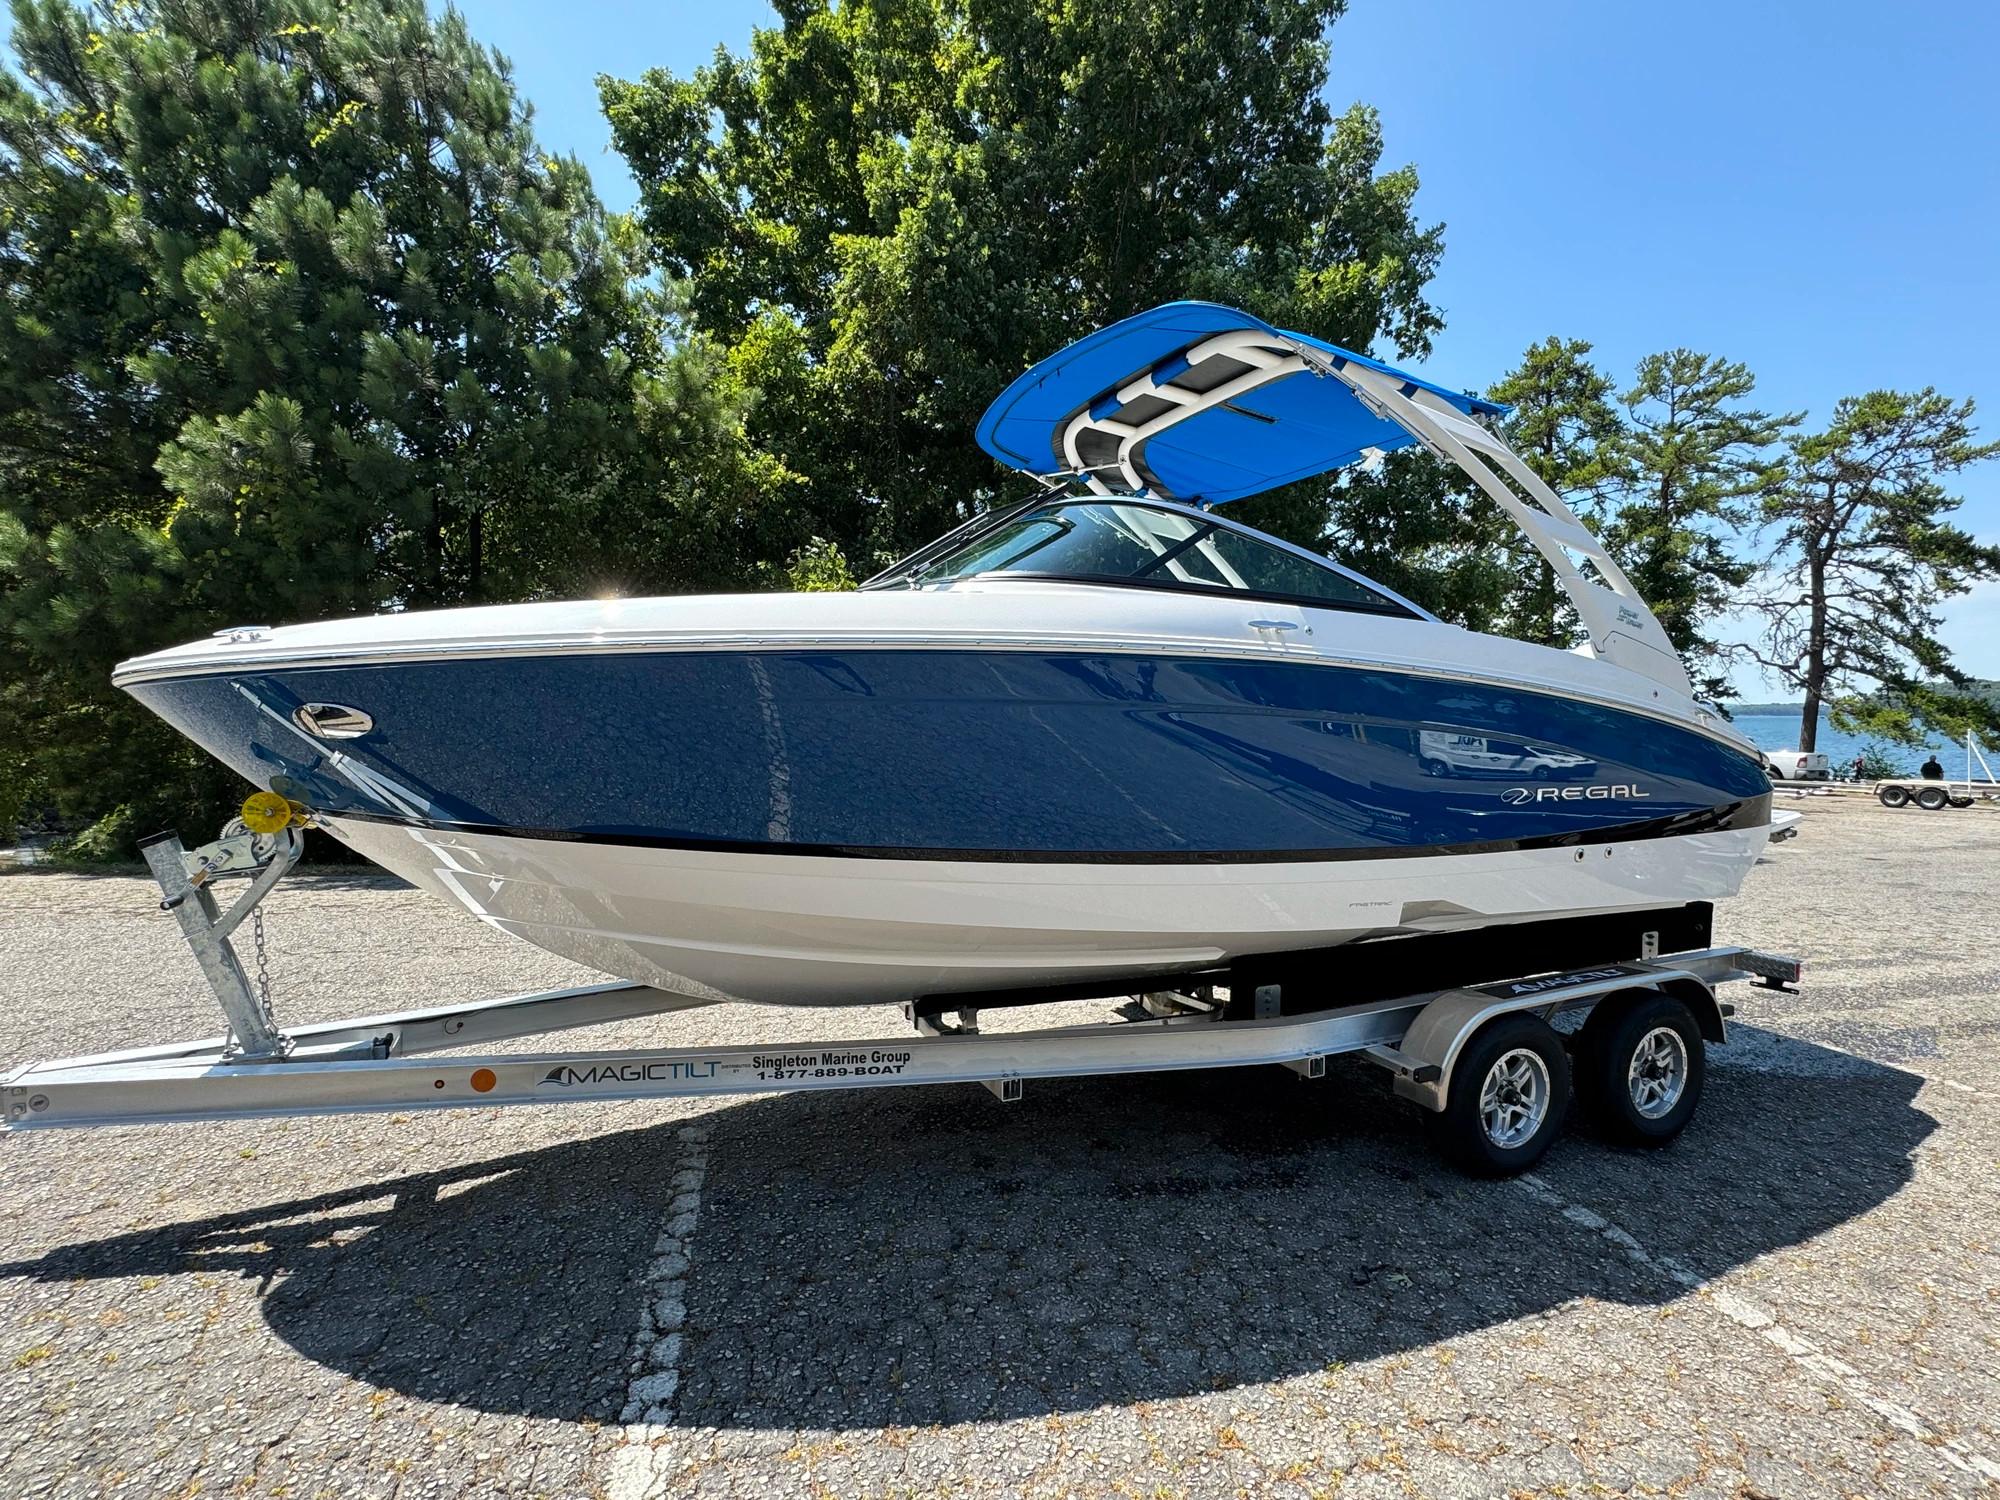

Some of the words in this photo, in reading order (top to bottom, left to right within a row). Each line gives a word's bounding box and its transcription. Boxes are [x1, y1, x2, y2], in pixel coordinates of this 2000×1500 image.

[1536, 784, 1650, 802] REGAL
[752, 1054, 817, 1071] Singleton
[821, 1051, 867, 1066] Marine
[871, 1050, 911, 1065] Group
[567, 1061, 722, 1084] MAGICTILT
[756, 1065, 905, 1081] 1-877-889-BOAT
